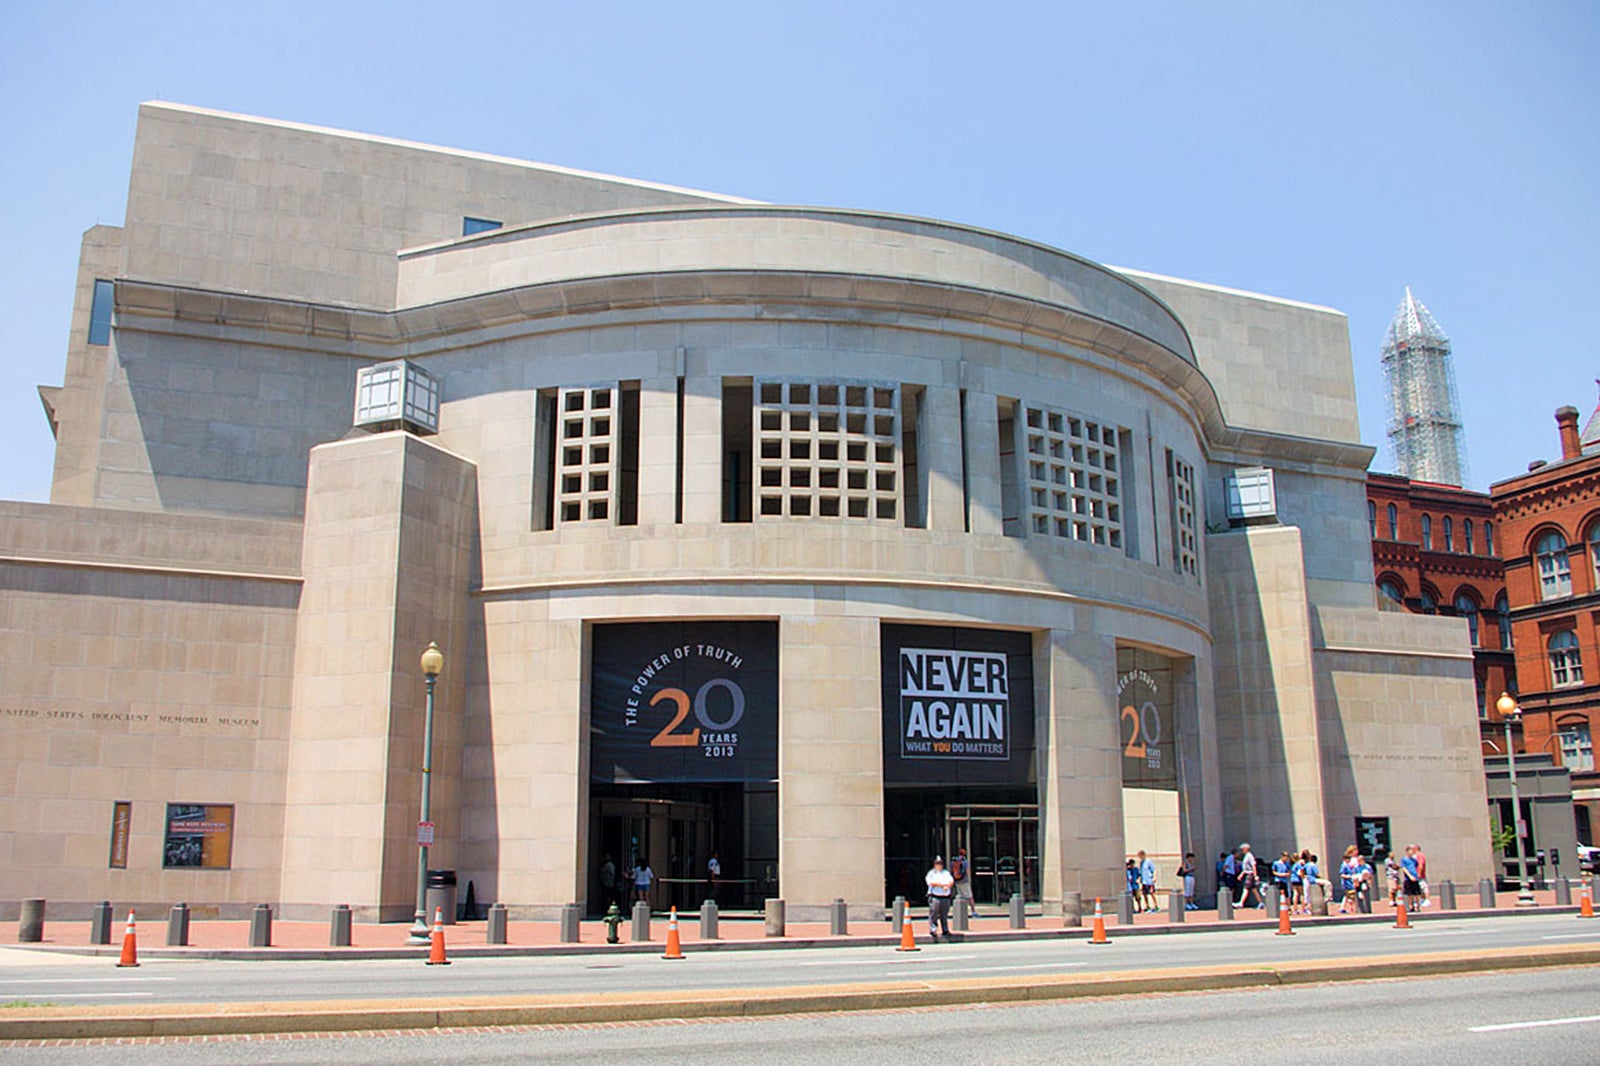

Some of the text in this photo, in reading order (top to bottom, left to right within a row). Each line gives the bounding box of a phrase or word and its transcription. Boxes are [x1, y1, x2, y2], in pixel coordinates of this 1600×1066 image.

[625, 645, 743, 726] THE POWER OF TRUTH
[902, 654, 1007, 693] NEVER
[46, 711, 84, 719] STATES
[650, 678, 745, 746] 20
[906, 701, 1004, 740] AGAIN
[1121, 702, 1161, 758] 20
[702, 734, 738, 743] YEARS
[705, 747, 734, 757] 2013
[906, 742, 1003, 754] WHAT YOU DO MATTERS
